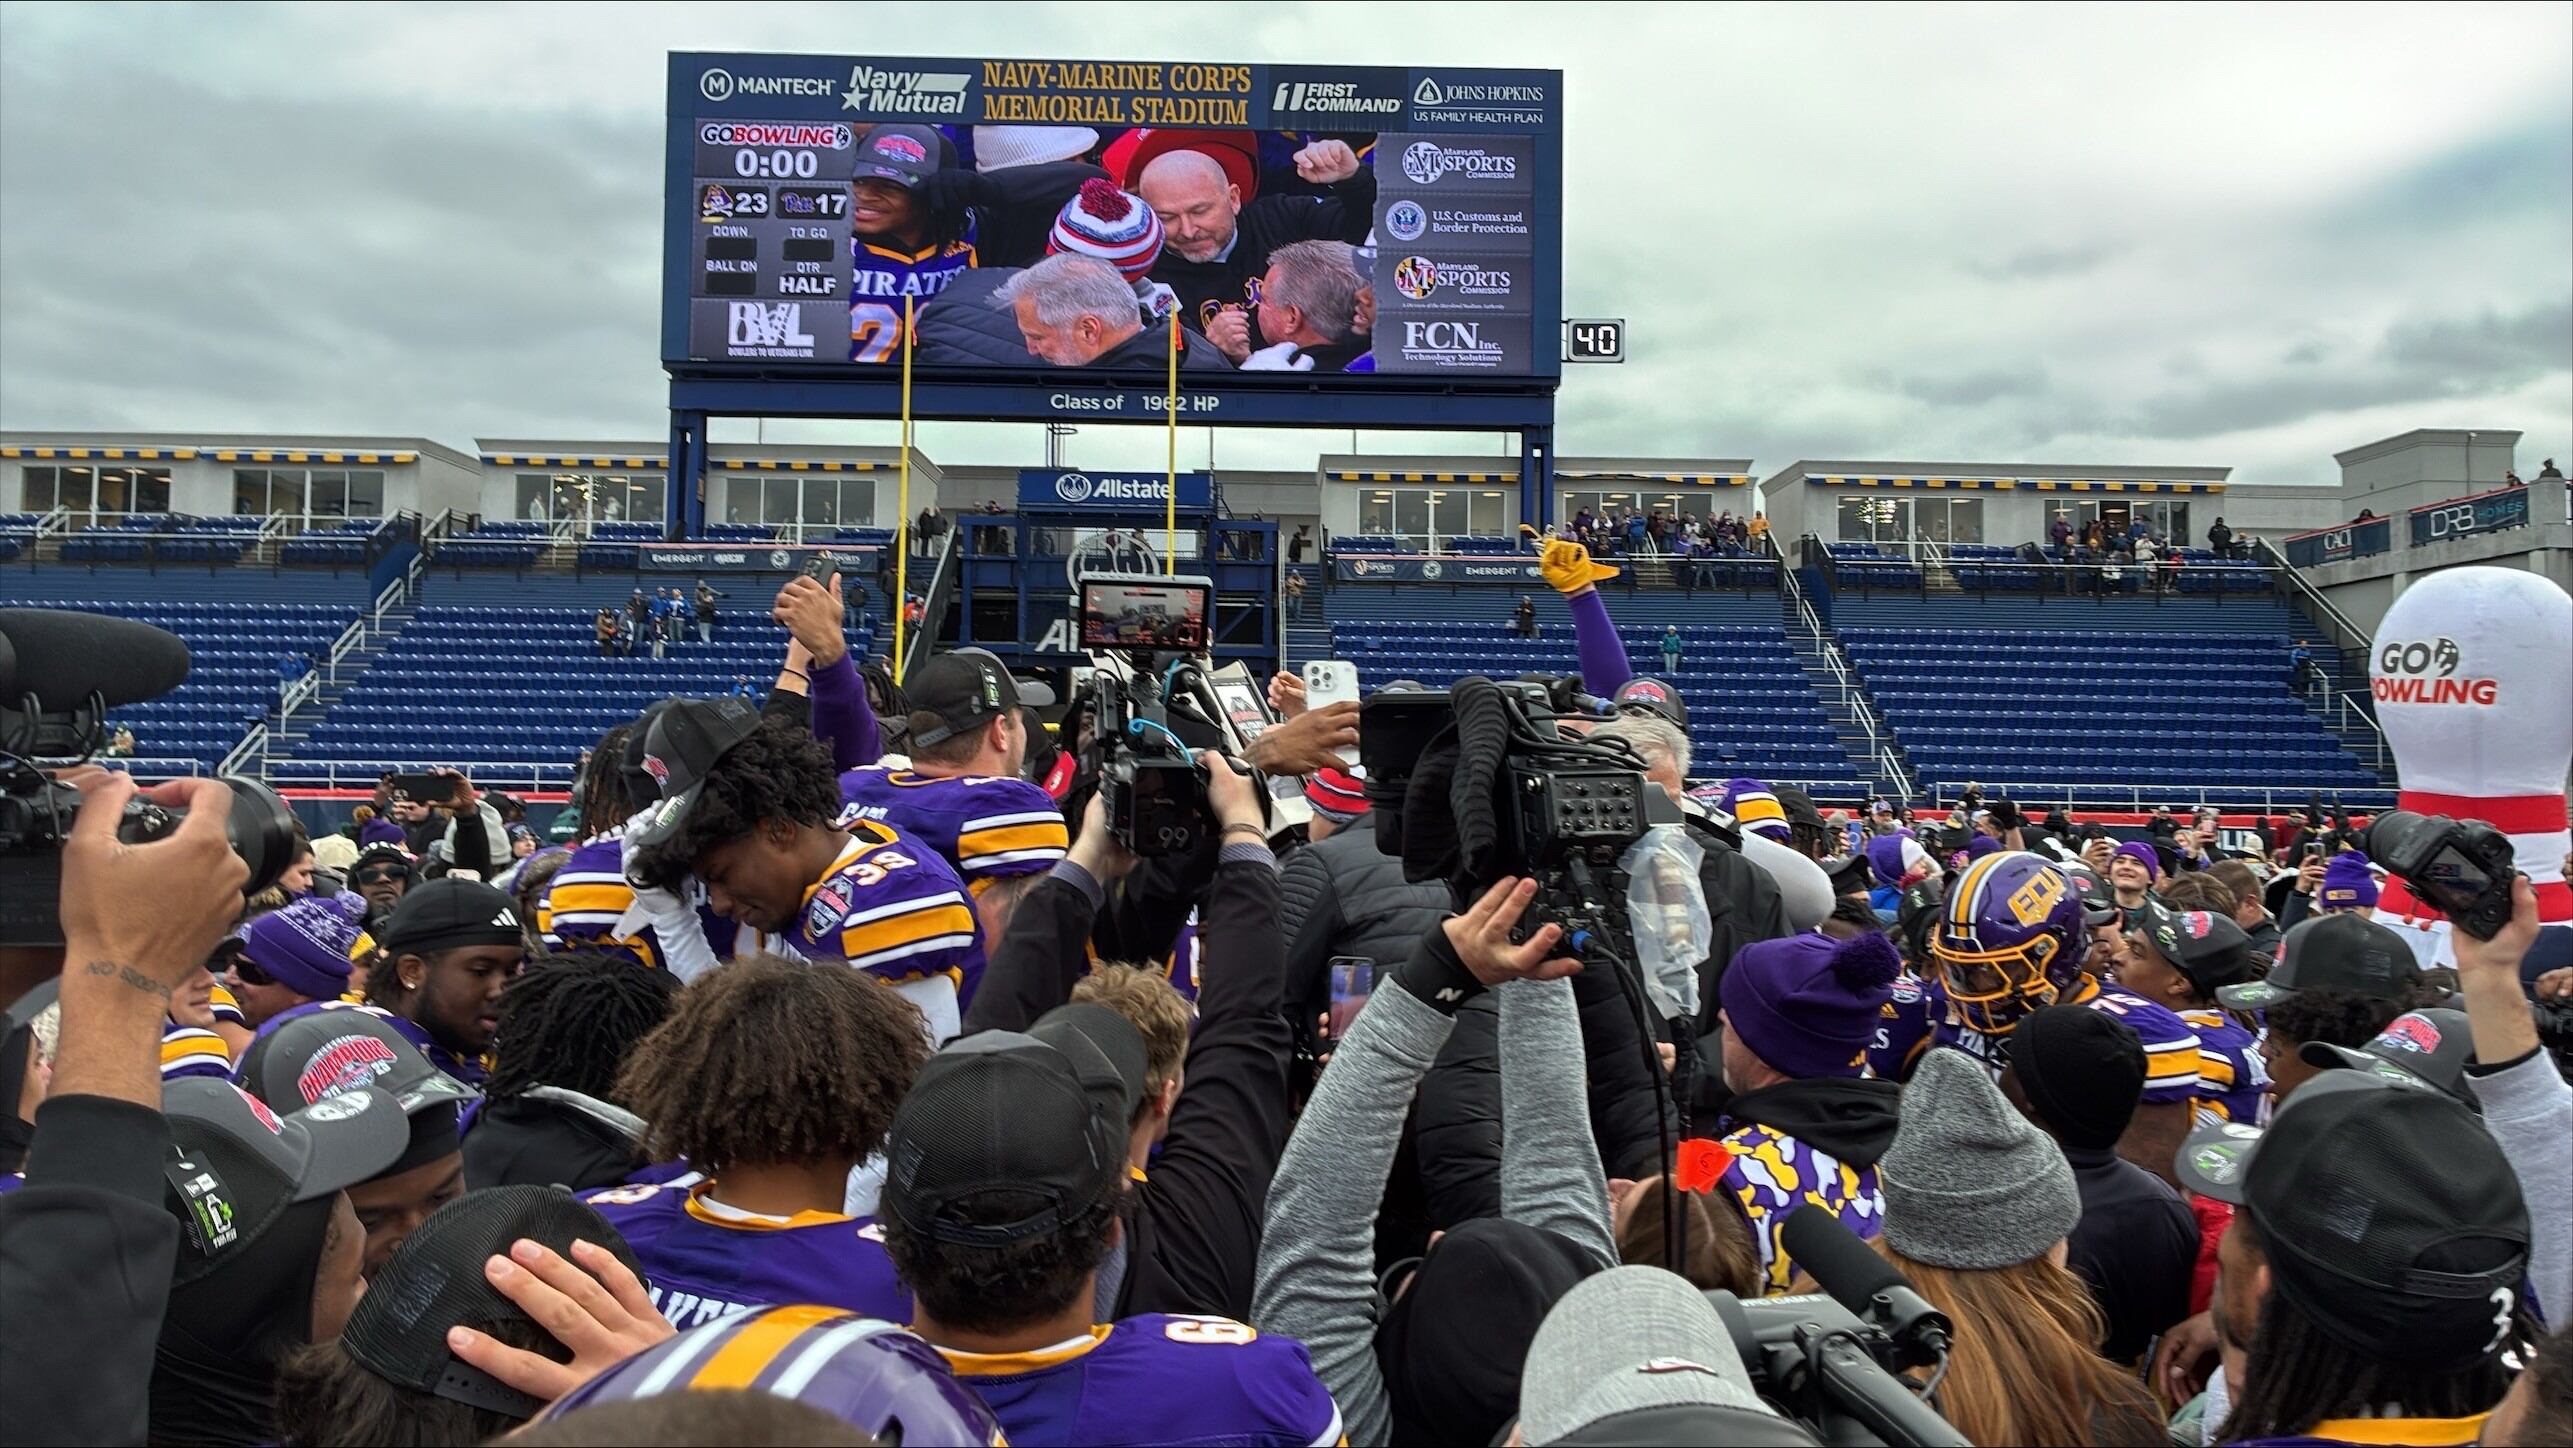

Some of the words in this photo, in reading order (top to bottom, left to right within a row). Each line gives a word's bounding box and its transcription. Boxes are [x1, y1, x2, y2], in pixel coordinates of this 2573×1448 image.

[738, 77, 832, 96] MANTECH
[850, 65, 920, 93] Navy
[982, 61, 1163, 91] NAVY-MARINE
[1169, 66, 1251, 93] CORPS
[1307, 83, 1357, 98] FIRST
[1444, 85, 1485, 103] JOHNS
[1488, 85, 1543, 102] HOPKINS
[868, 90, 967, 114] Mutual
[984, 94, 1126, 123] MEMORIAL
[1131, 97, 1249, 125] STADIUM
[1303, 97, 1400, 113] COMMAND
[1414, 111, 1429, 122] US
[1430, 111, 1468, 123] FAMILY
[1469, 112, 1511, 123] HEALTH
[1514, 113, 1543, 124] PLAN
[735, 148, 818, 178] 0:00
[1444, 156, 1516, 172] SPORTS
[735, 192, 768, 213] 23
[815, 193, 847, 214] 17
[1454, 211, 1501, 222] Customs
[1502, 212, 1523, 222] and
[712, 225, 749, 237] DOWN
[790, 227, 805, 238] TO
[810, 227, 828, 238] GO
[1432, 223, 1469, 233] Border
[1472, 223, 1528, 234] Protection
[705, 260, 736, 272] BALL
[740, 260, 758, 272] ON
[779, 275, 837, 295] HALF
[1437, 271, 1511, 288] SPORTS
[1403, 321, 1480, 349] FCN
[1576, 326, 1616, 354] 40
[1404, 353, 1457, 363] Technology
[1457, 353, 1502, 362] Solutions
[1050, 394, 1101, 410] Class
[1103, 395, 1125, 410] of
[1194, 395, 1220, 412] HP
[1093, 479, 1173, 499] Allstate
[2430, 504, 2476, 537] DRB
[2477, 501, 2524, 518] HOMES
[651, 553, 704, 563] EMERGENT
[1466, 566, 1517, 577] EMERGENT
[2381, 642, 2431, 675] GO
[1159, 826, 1189, 848] 99
[2007, 866, 2067, 922] ECU
